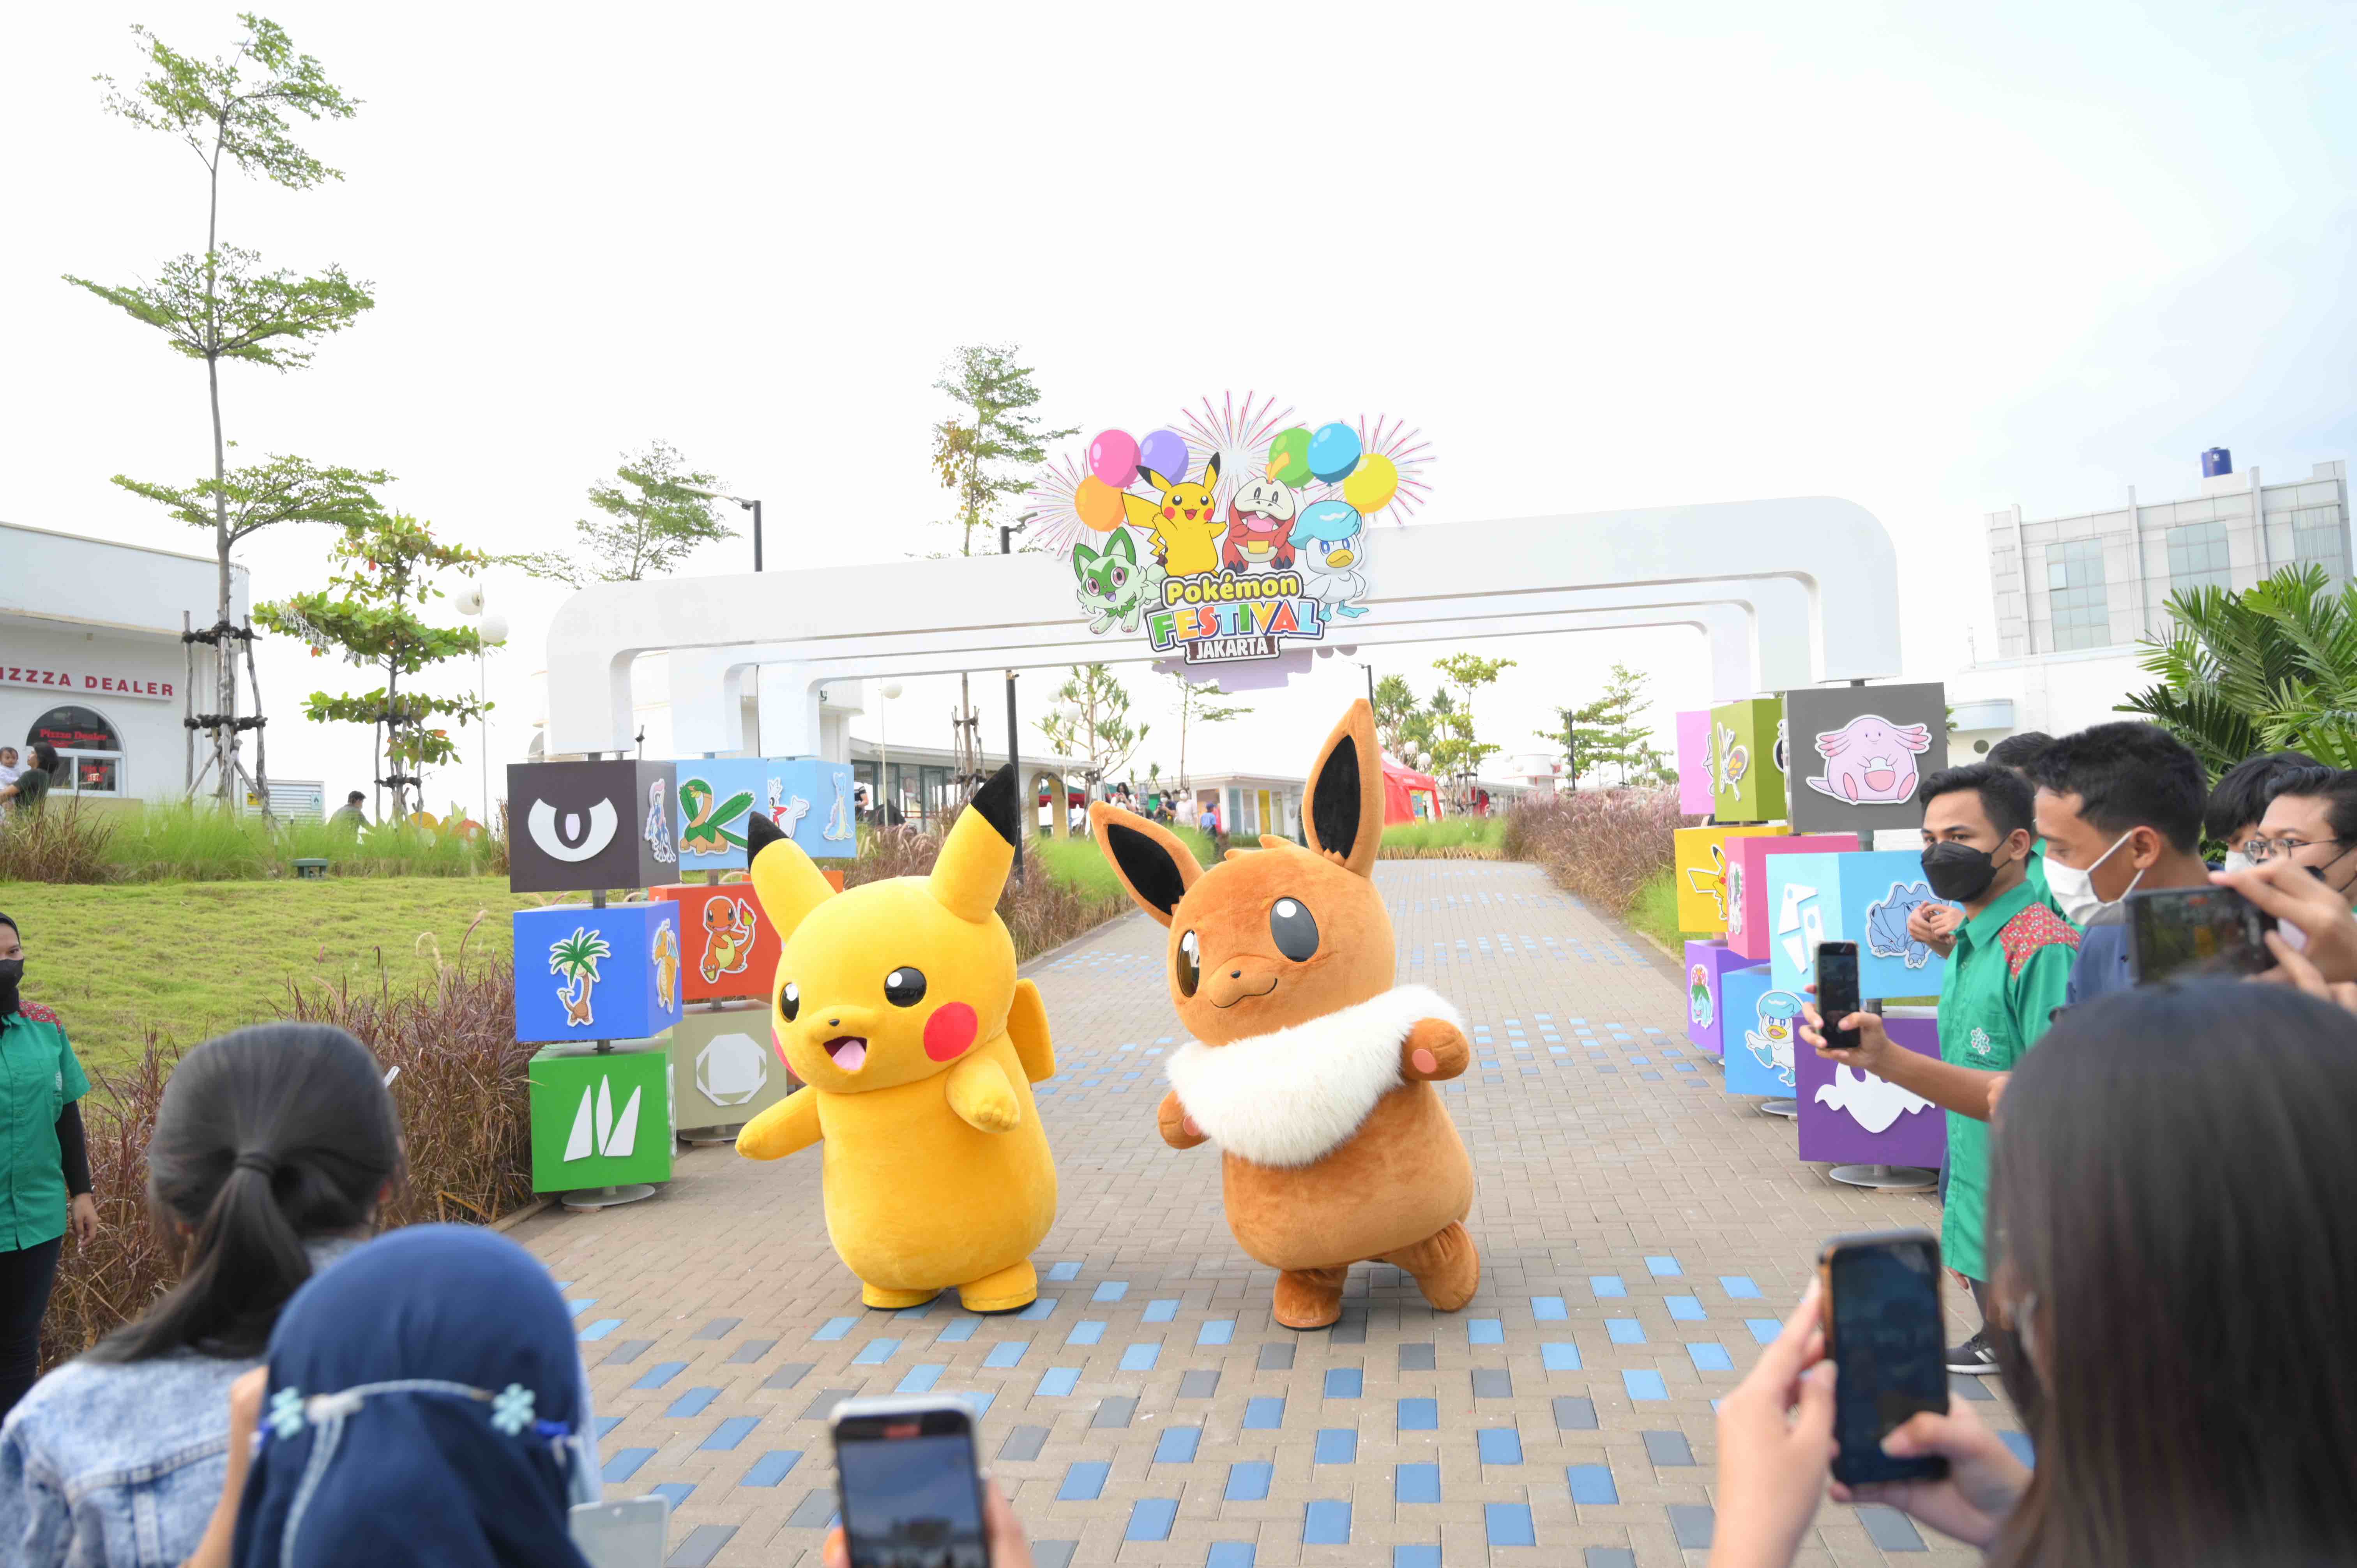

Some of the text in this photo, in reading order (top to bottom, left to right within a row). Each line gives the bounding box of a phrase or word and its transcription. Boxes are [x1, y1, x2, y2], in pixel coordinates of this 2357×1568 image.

[1166, 574, 1298, 604] Pokémon
[1152, 600, 1320, 646] FESTIVAL
[1196, 637, 1269, 659] JAKARTA
[85, 676, 173, 696] DEALER
